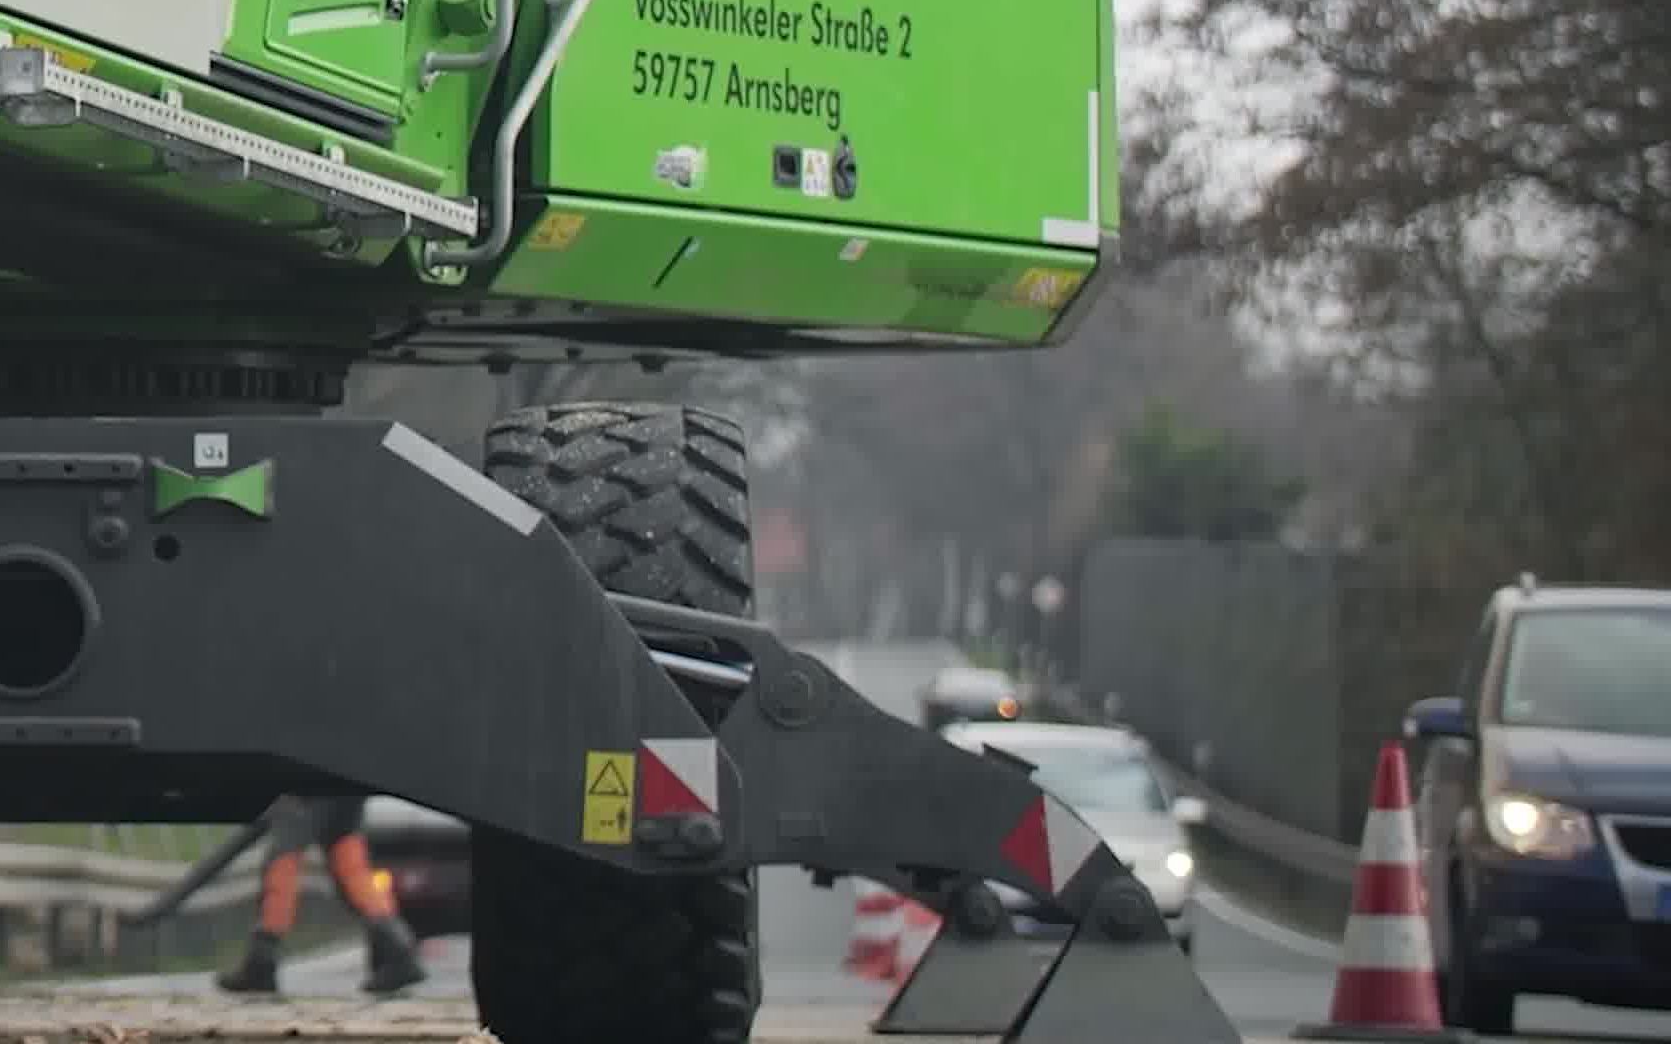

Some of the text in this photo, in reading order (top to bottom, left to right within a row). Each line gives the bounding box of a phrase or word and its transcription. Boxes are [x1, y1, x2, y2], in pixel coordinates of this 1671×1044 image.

[811, 1, 889, 55] Straße
[899, 16, 912, 58] 2
[632, 51, 841, 131] 59757 Arnsberg
